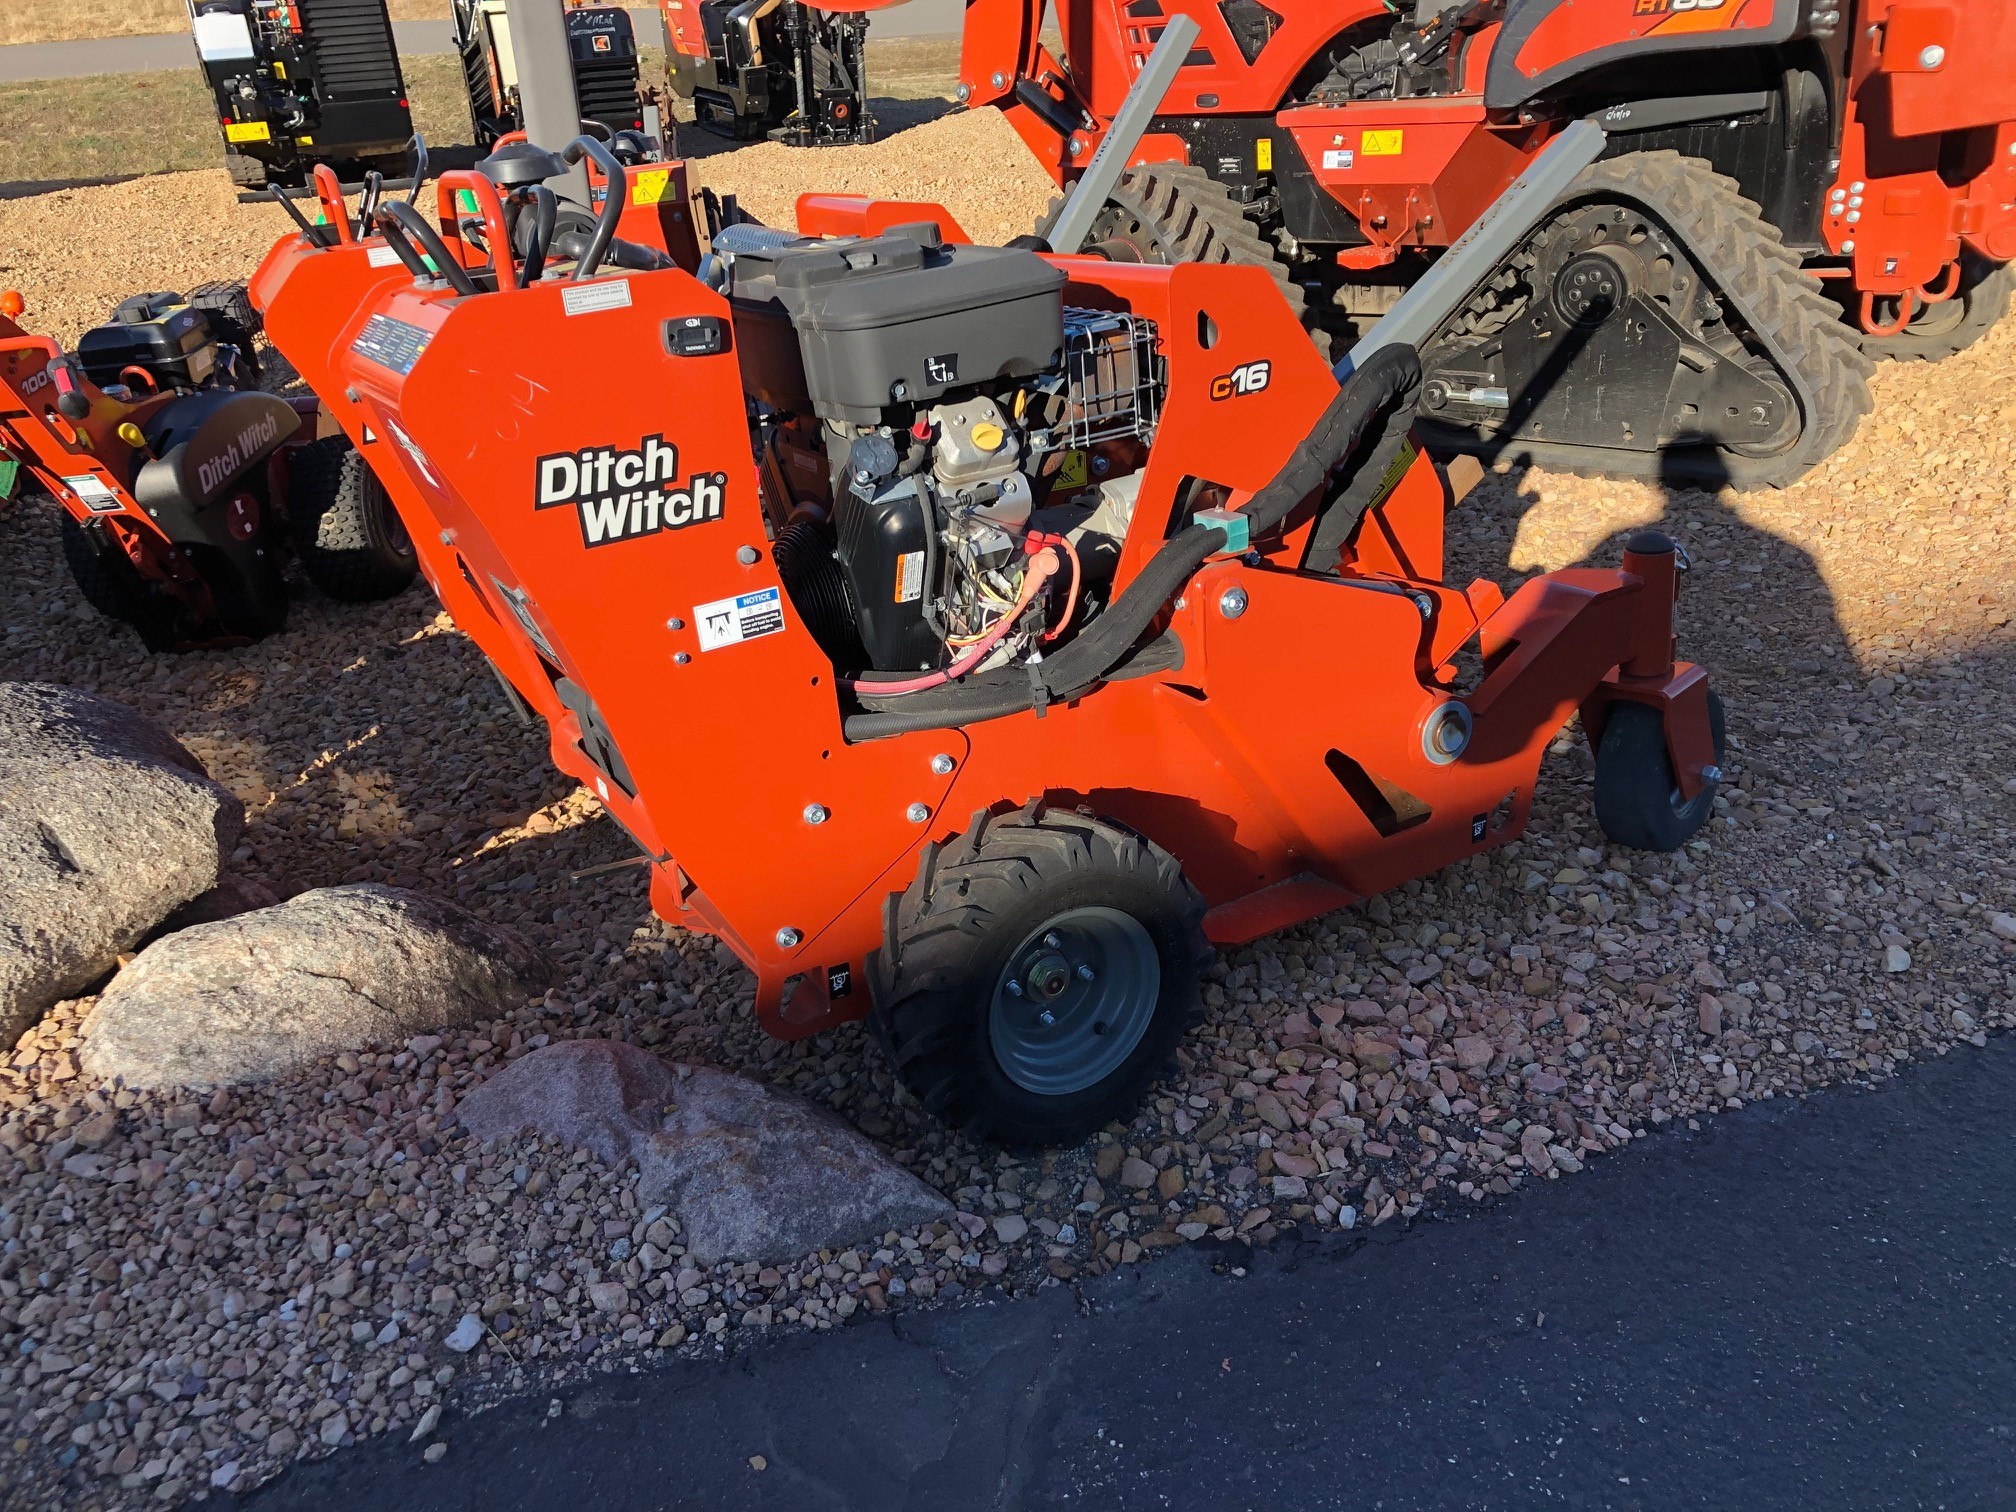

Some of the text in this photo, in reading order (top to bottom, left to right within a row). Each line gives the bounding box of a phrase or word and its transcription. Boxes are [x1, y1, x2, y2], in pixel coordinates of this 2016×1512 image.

[1212, 362, 1269, 398] C16
[198, 411, 278, 495] Ditch Witch
[540, 438, 674, 504] Ditch
[743, 592, 772, 606] NOTICE
